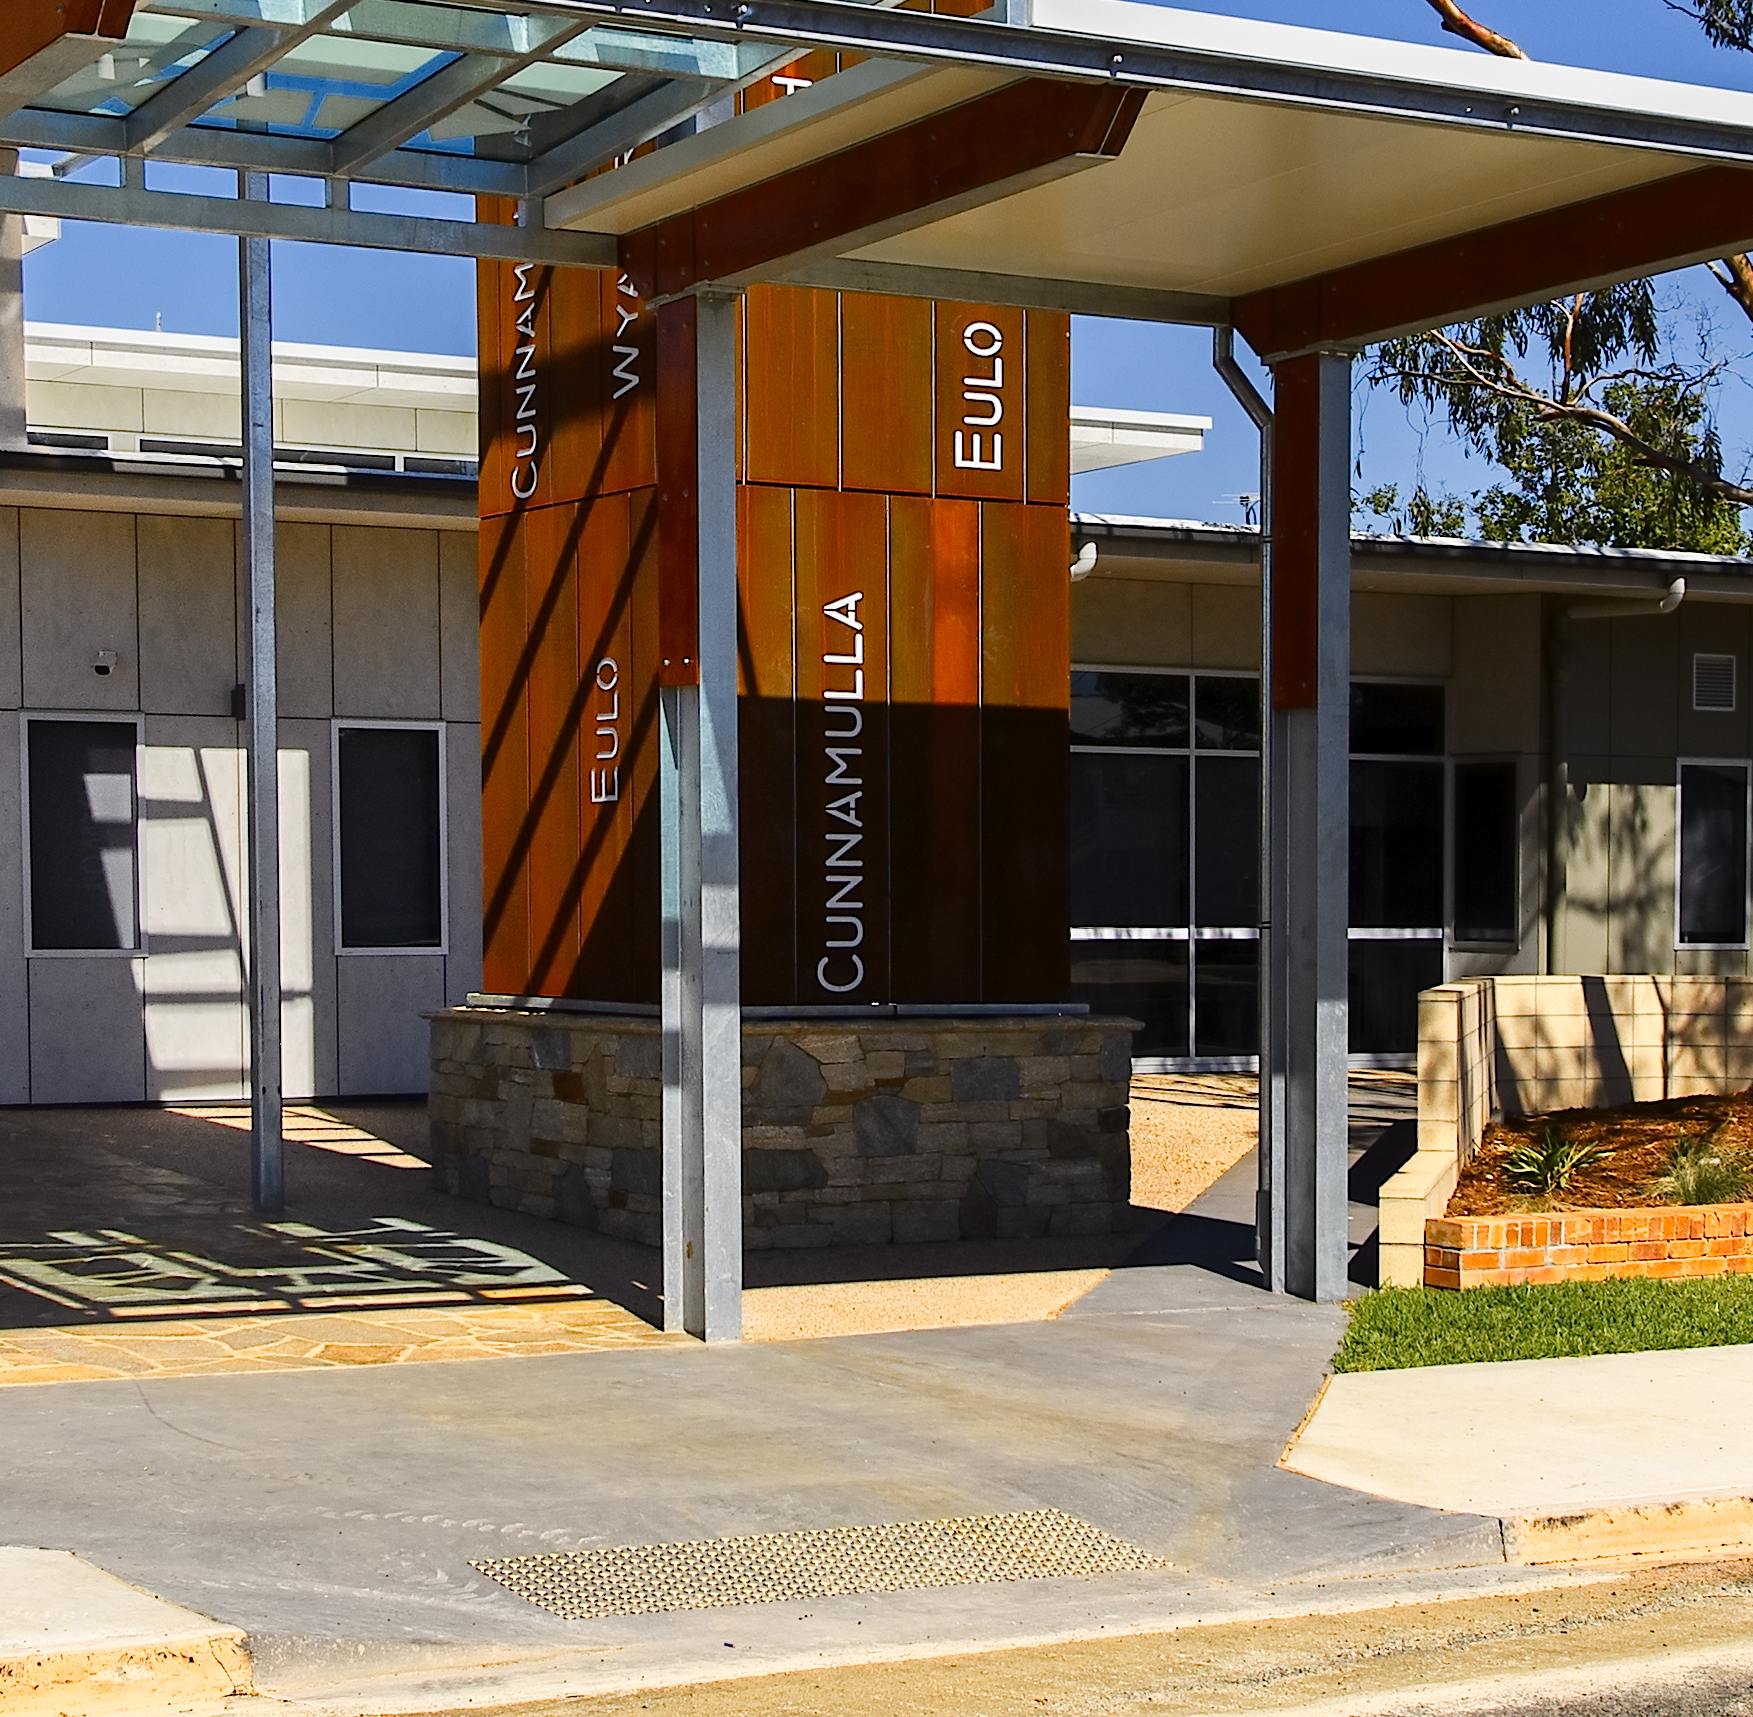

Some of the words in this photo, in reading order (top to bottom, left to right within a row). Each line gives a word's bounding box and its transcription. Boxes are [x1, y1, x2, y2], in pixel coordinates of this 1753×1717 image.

[955, 321, 1003, 471] EULO
[591, 656, 619, 804] EULO
[817, 591, 865, 993] CUNNAMULLA
